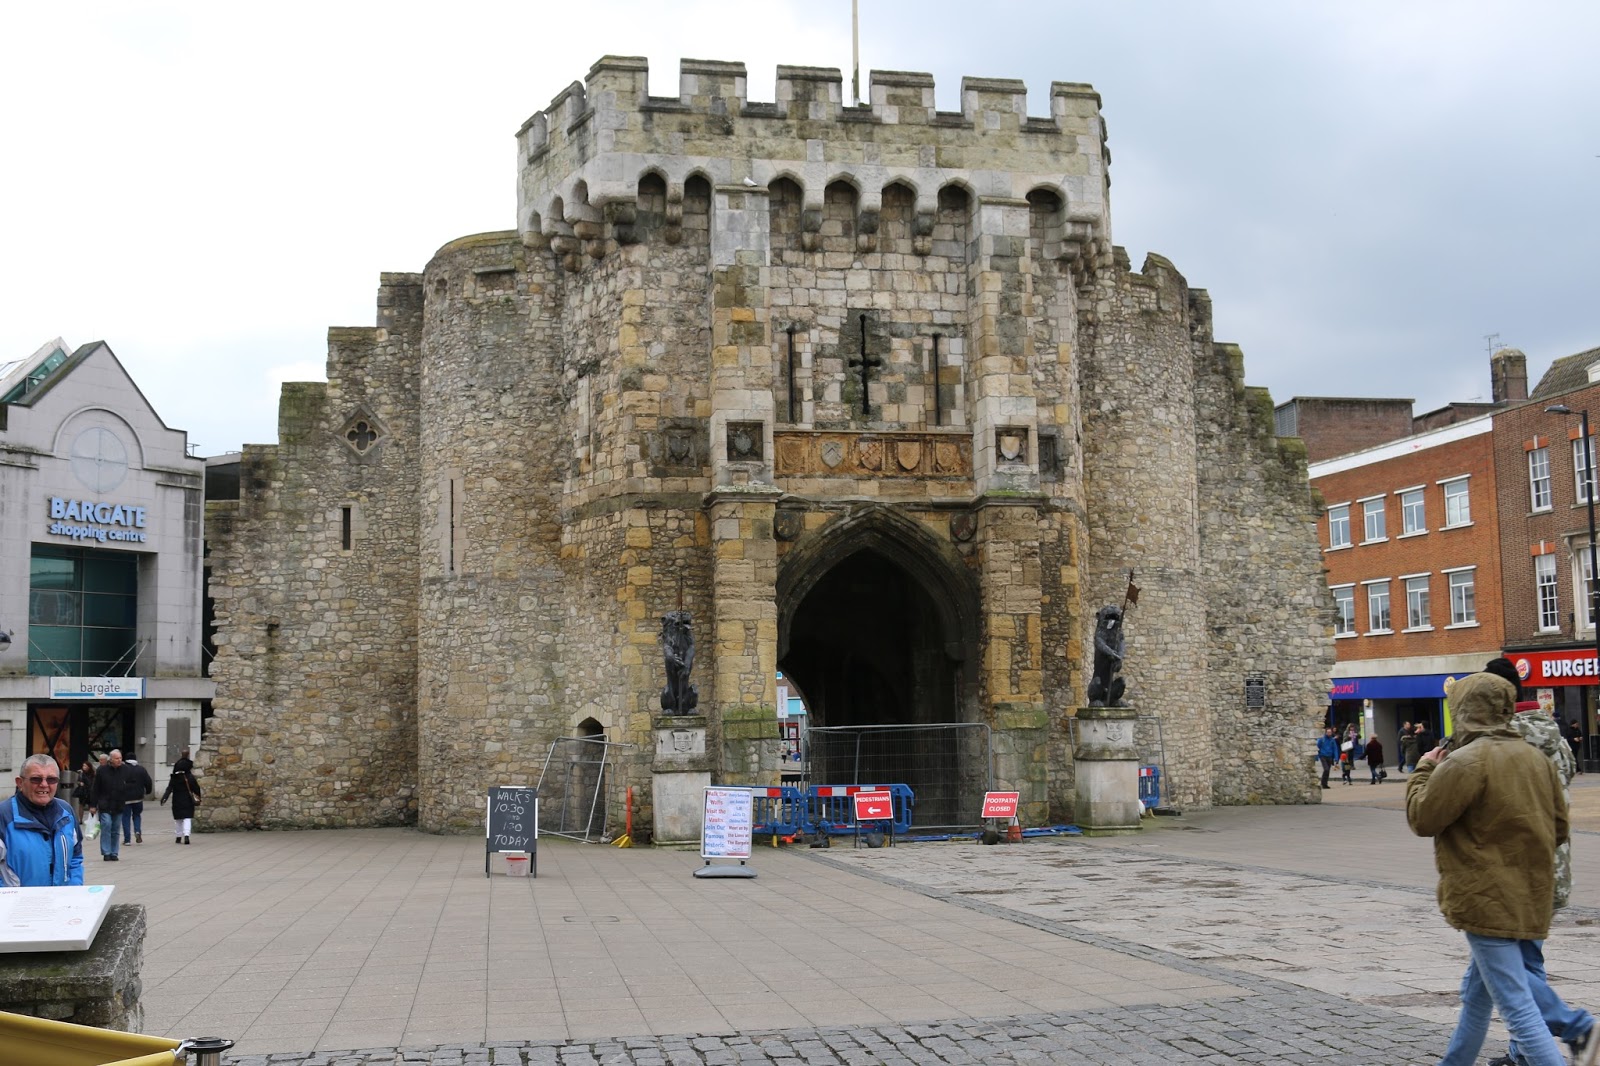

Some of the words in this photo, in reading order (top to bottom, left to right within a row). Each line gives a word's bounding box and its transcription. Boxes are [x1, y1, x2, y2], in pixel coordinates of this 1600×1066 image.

[51, 496, 146, 528] BARGATE
[50, 520, 107, 542] shopping
[108, 529, 146, 542] centre
[80, 682, 120, 695] bargate
[497, 791, 530, 804] WALKS
[494, 802, 525, 815] 10.30
[494, 834, 529, 846] TODAY
